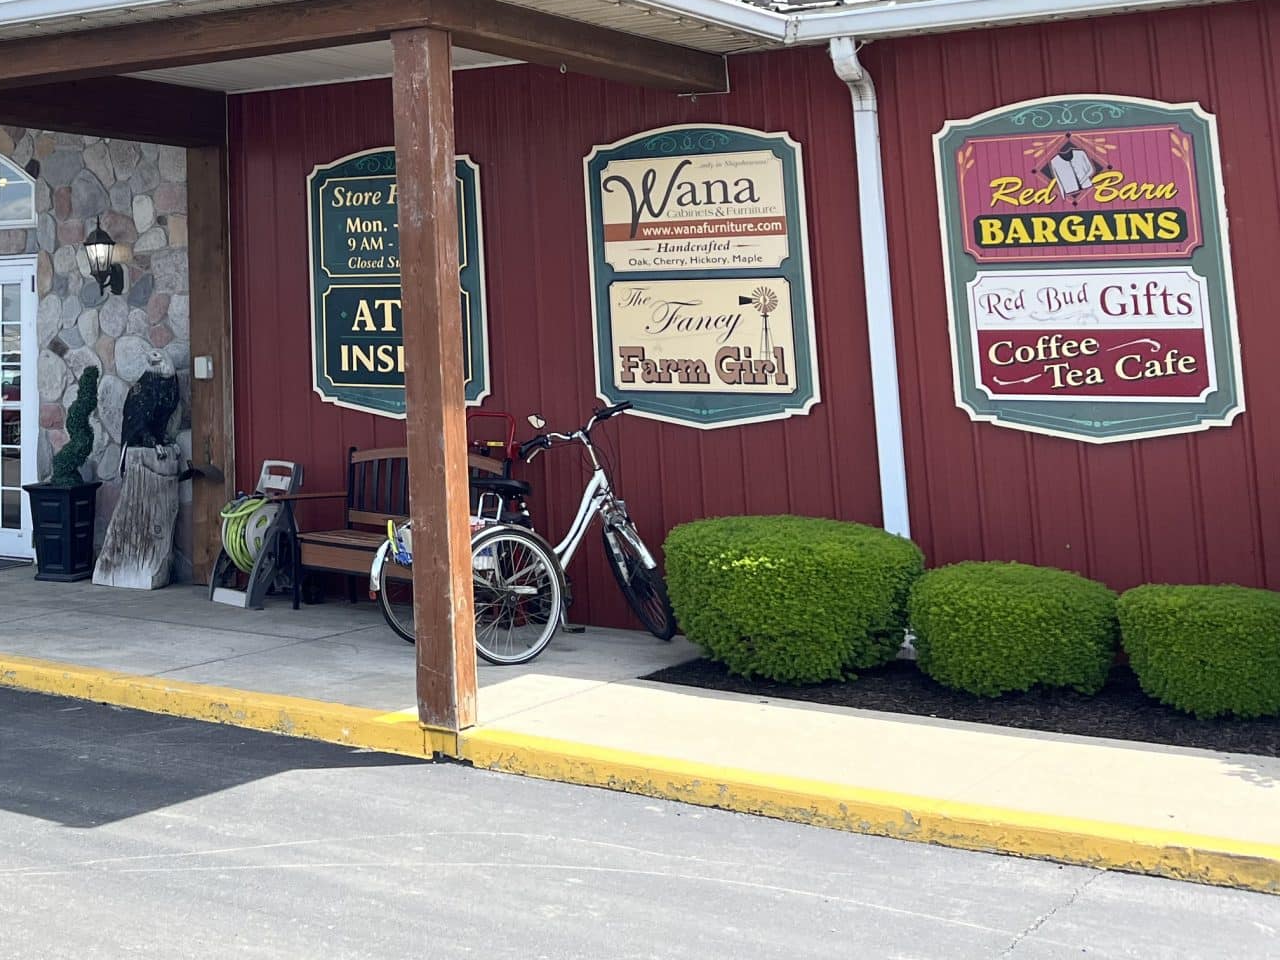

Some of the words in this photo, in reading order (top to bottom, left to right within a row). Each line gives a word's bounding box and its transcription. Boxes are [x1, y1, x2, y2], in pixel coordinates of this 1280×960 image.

[331, 186, 381, 207] Store
[602, 159, 760, 239] Wana
[988, 176, 1059, 208] Red
[1092, 171, 1178, 203] Barn
[345, 217, 388, 233] Mon.
[642, 220, 782, 237] www.wanafurniture.com
[978, 211, 1182, 246] BARGAINS
[347, 238, 356, 251] 9
[360, 236, 384, 251] AM
[656, 240, 731, 254] Handcrafted
[348, 256, 384, 269] Closed
[628, 257, 651, 267] Oak,
[653, 256, 688, 267] Cherry,
[689, 254, 730, 266] Hickory,
[732, 253, 763, 264] Maple
[351, 299, 402, 331] AT
[617, 287, 652, 309] The
[645, 299, 744, 344] Fancy
[978, 288, 1027, 320] Red
[1036, 283, 1089, 314] Bud
[1099, 281, 1194, 318] Gifts
[340, 345, 405, 373] INSI
[619, 346, 710, 384] Farm
[714, 346, 789, 386] Girl
[987, 334, 1100, 367] Coffee
[1043, 363, 1105, 389] Tea
[1114, 349, 1198, 382] Cafe
